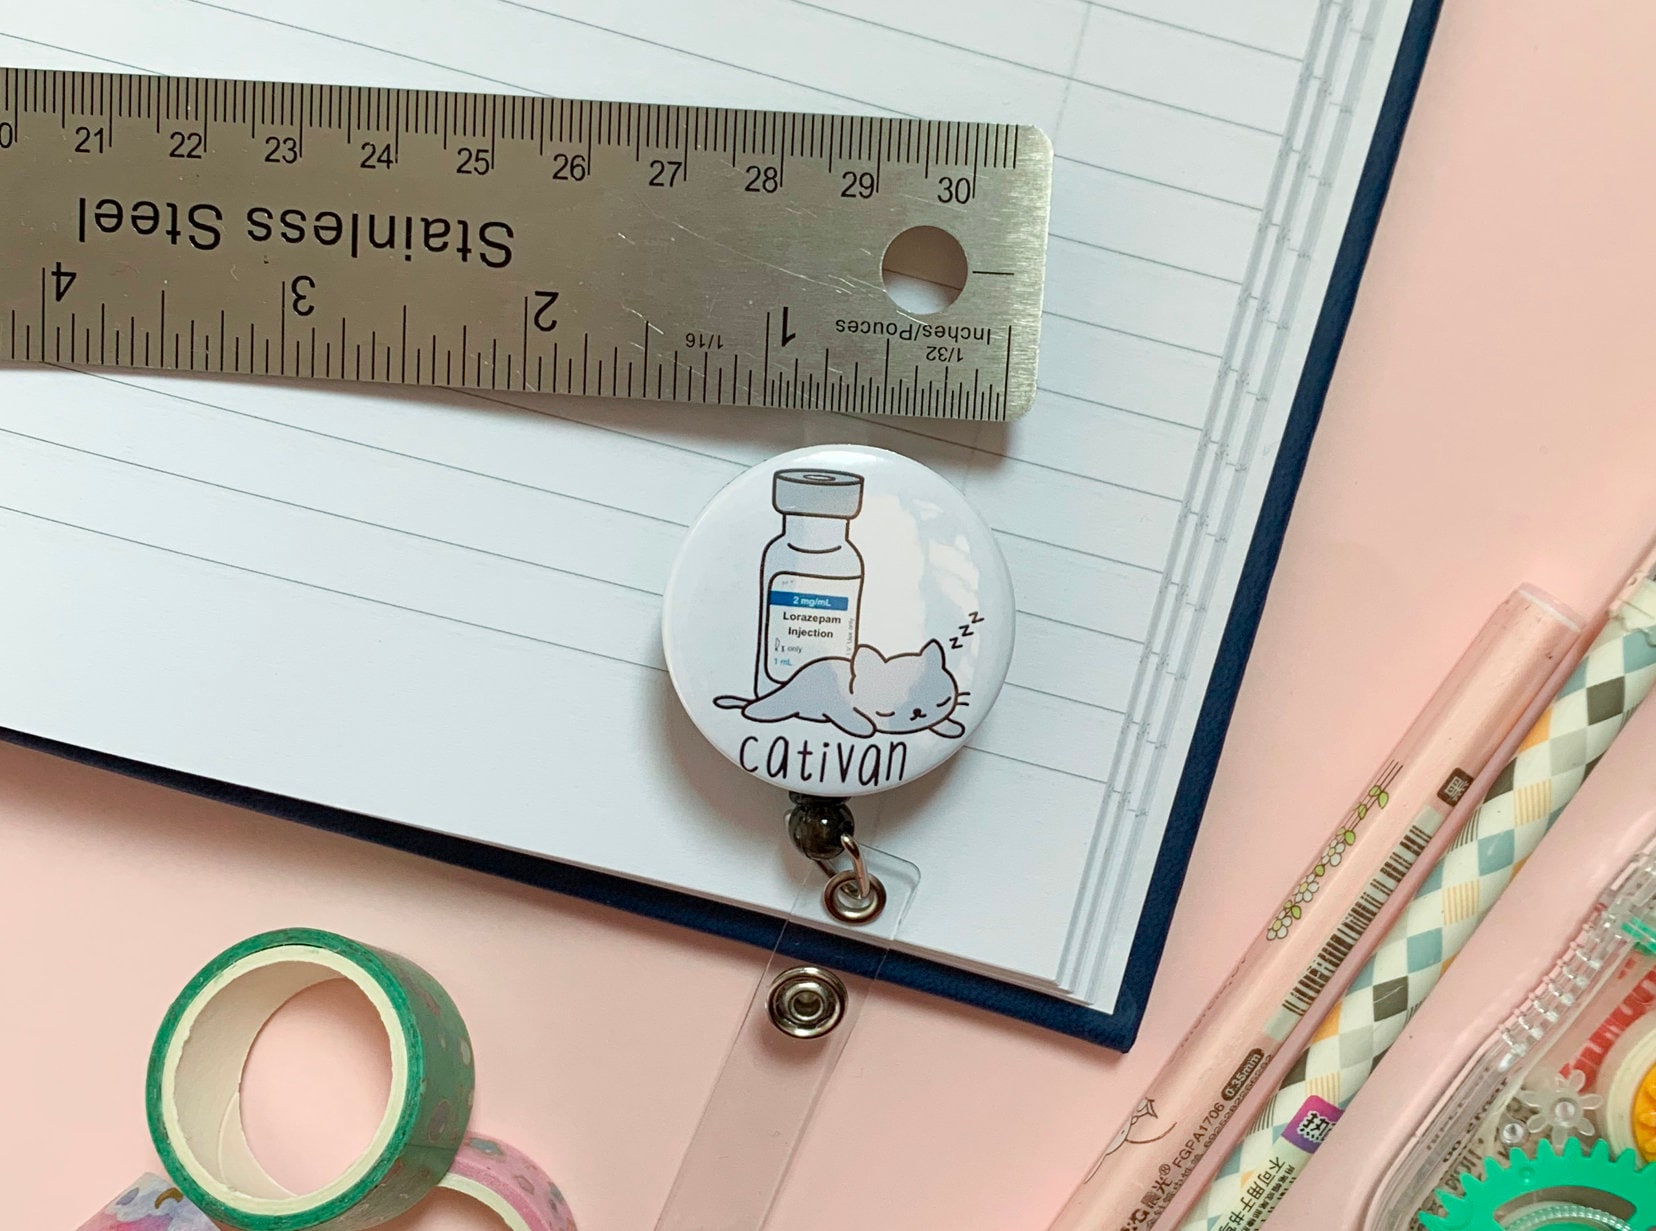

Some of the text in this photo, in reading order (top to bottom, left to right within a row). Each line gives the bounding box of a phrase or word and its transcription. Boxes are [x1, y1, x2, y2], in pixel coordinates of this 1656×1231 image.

[74, 126, 104, 154] 21
[168, 131, 203, 160] 22
[264, 136, 298, 165] 23
[359, 141, 394, 170] 24
[456, 147, 490, 176] 25
[552, 153, 586, 182] 26
[648, 159, 683, 188] 27
[744, 165, 779, 194] 28
[840, 170, 875, 200] 29
[937, 176, 971, 205] 30
[78, 197, 514, 269] Stainless Steel
[50, 261, 797, 348] 1 2 3 4
[685, 332, 725, 351] 1/16
[834, 317, 992, 346] Inches/Pouces
[925, 345, 965, 363] 1/32
[792, 595, 832, 607] 2 mg/mL
[782, 610, 842, 625] Lorazepam
[788, 626, 834, 639] Injection
[739, 735, 908, 787] cativan
[1171, 1052, 1261, 1169] FGPA1706 0.35mm
